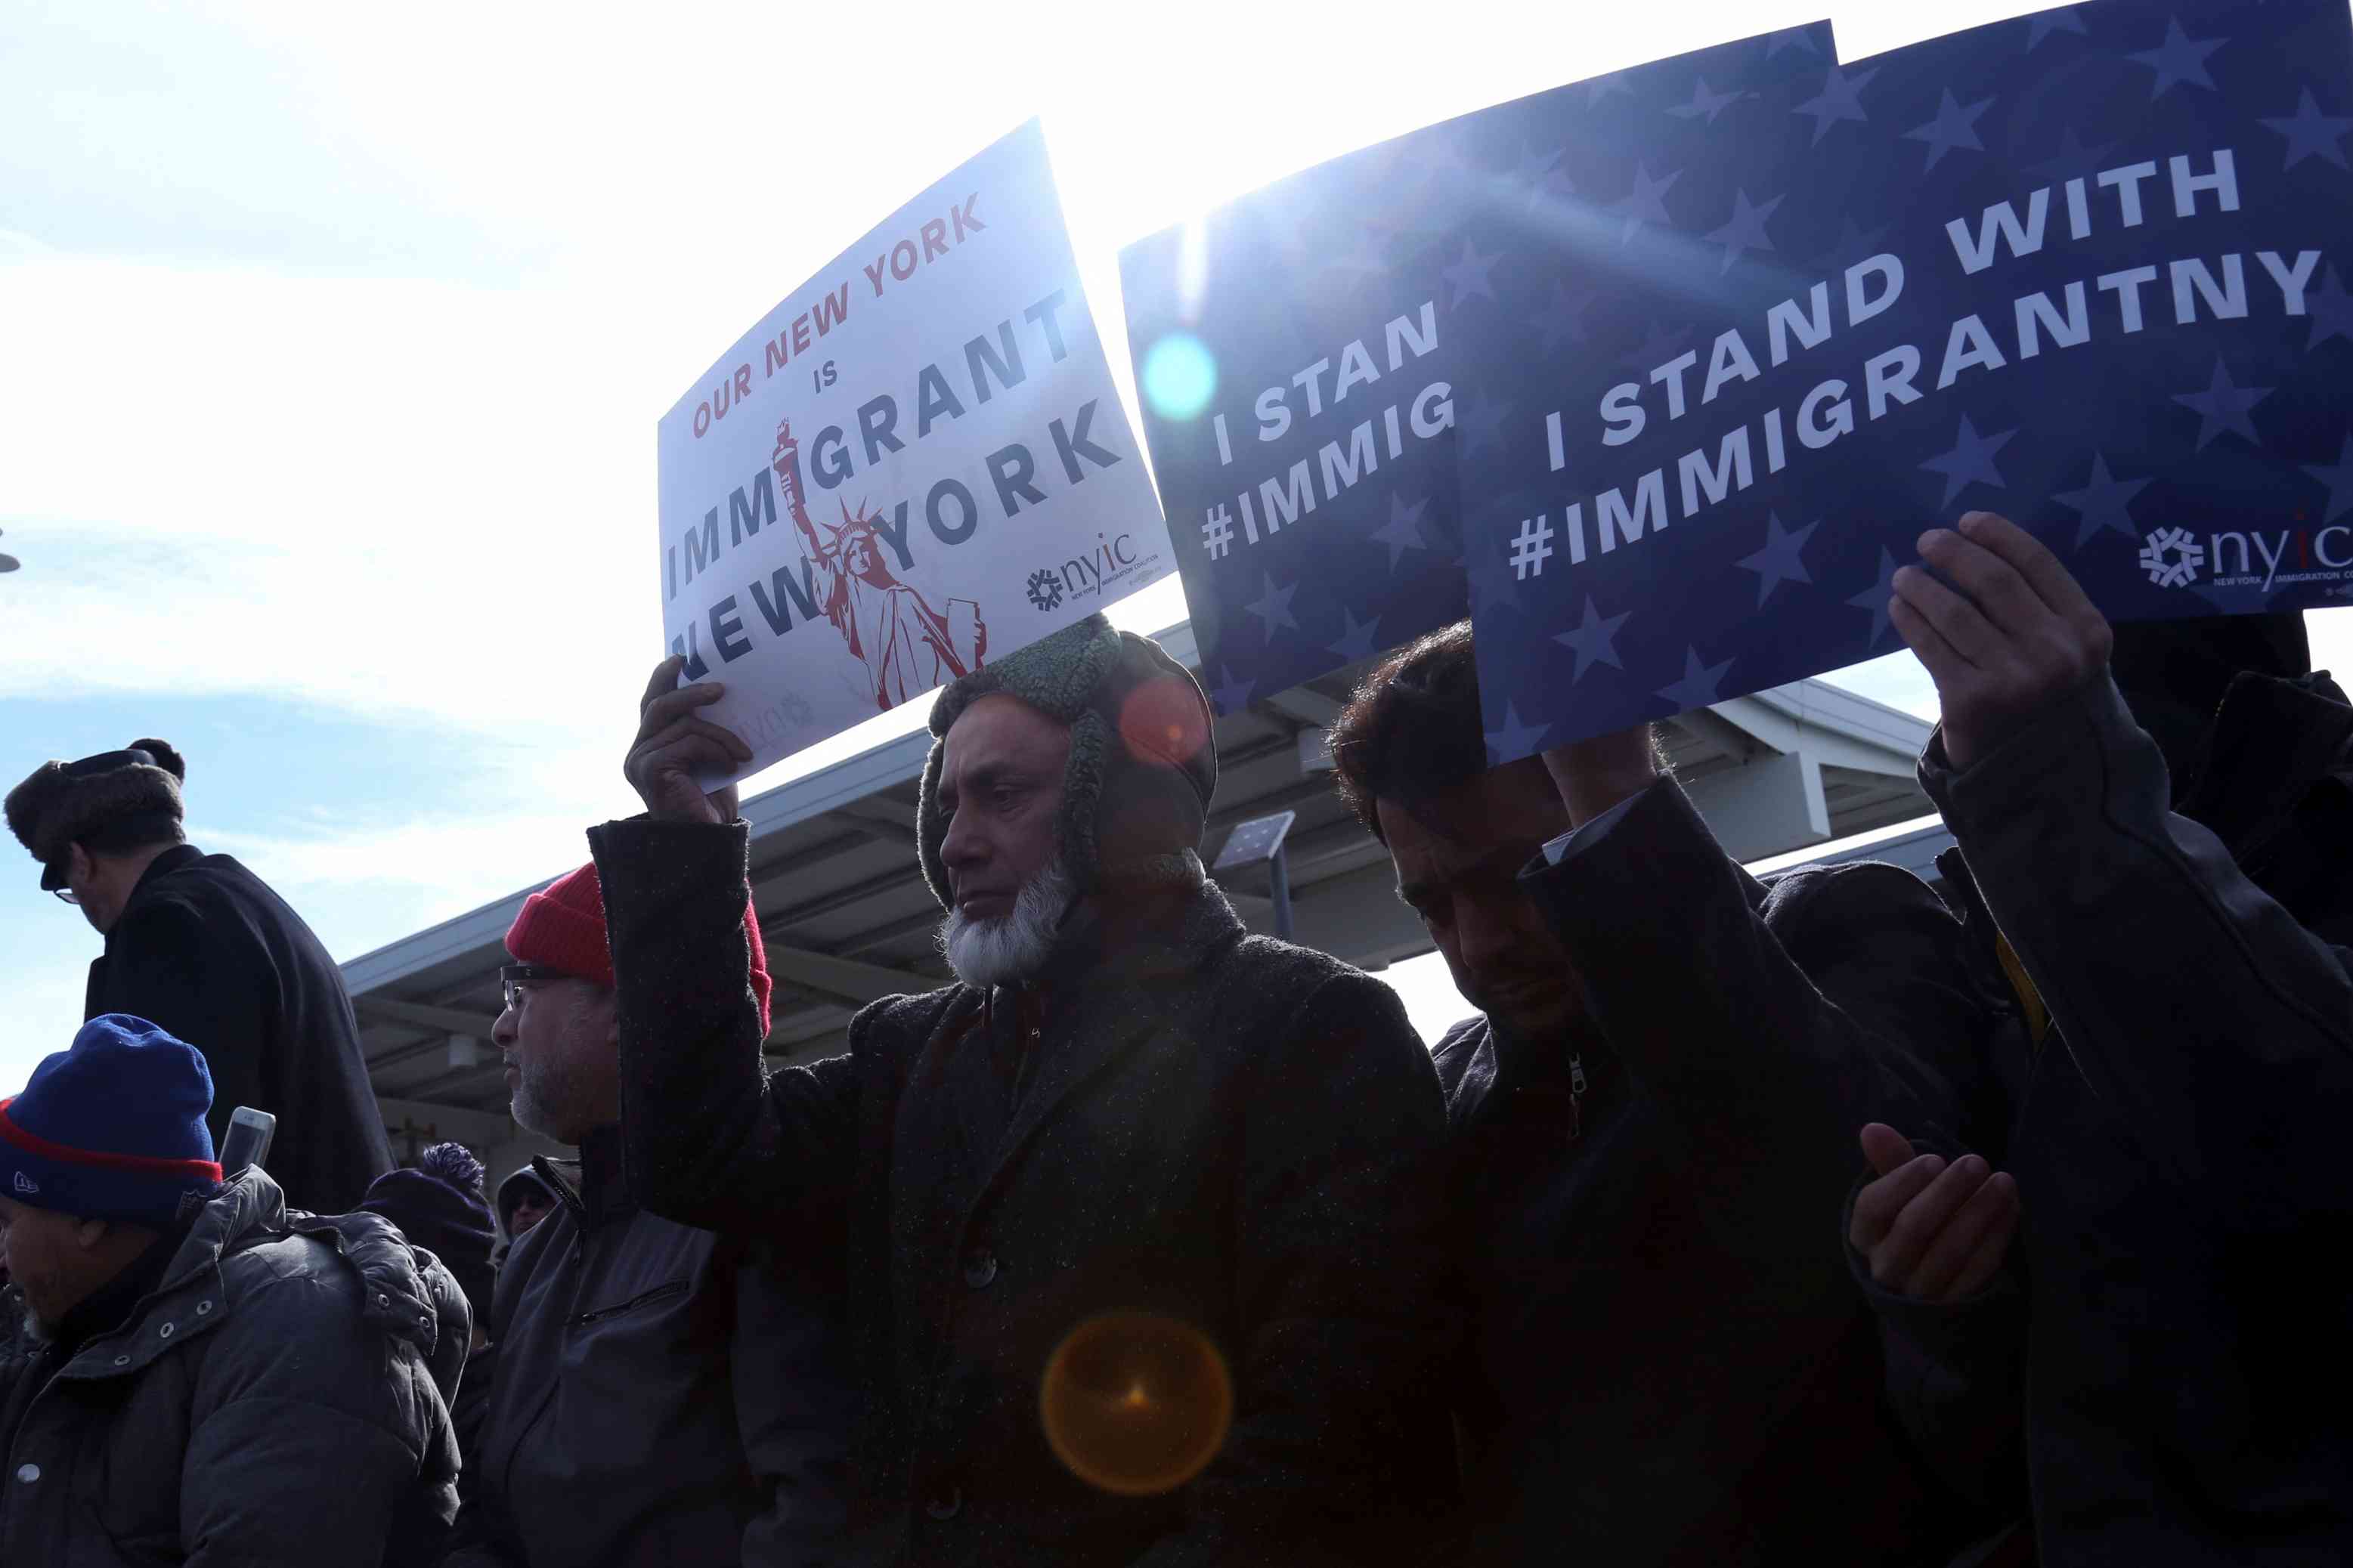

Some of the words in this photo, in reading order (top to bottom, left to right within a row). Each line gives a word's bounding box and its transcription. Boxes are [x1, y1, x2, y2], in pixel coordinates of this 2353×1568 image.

[692, 363, 754, 440] OUR
[763, 282, 849, 381] NEW
[863, 191, 988, 299] YORK
[813, 360, 837, 395] IS
[1213, 413, 1234, 466] I
[1254, 300, 1438, 443] STAN
[1509, 249, 2324, 580] #IMMIGRANTNY
[1545, 411, 1565, 471] I
[1599, 252, 1906, 447] STAND
[1944, 147, 2240, 277] WITH
[667, 288, 1067, 602] IMMIGRANT
[670, 555, 821, 683] NEW
[869, 398, 1122, 572] YORK
[1201, 381, 1455, 561] #IMMIG
[1060, 532, 1137, 595] nyic
[2214, 577, 2235, 586] NEW
[2237, 575, 2262, 586] YORK
[2274, 571, 2340, 583] IMMIGRATION
